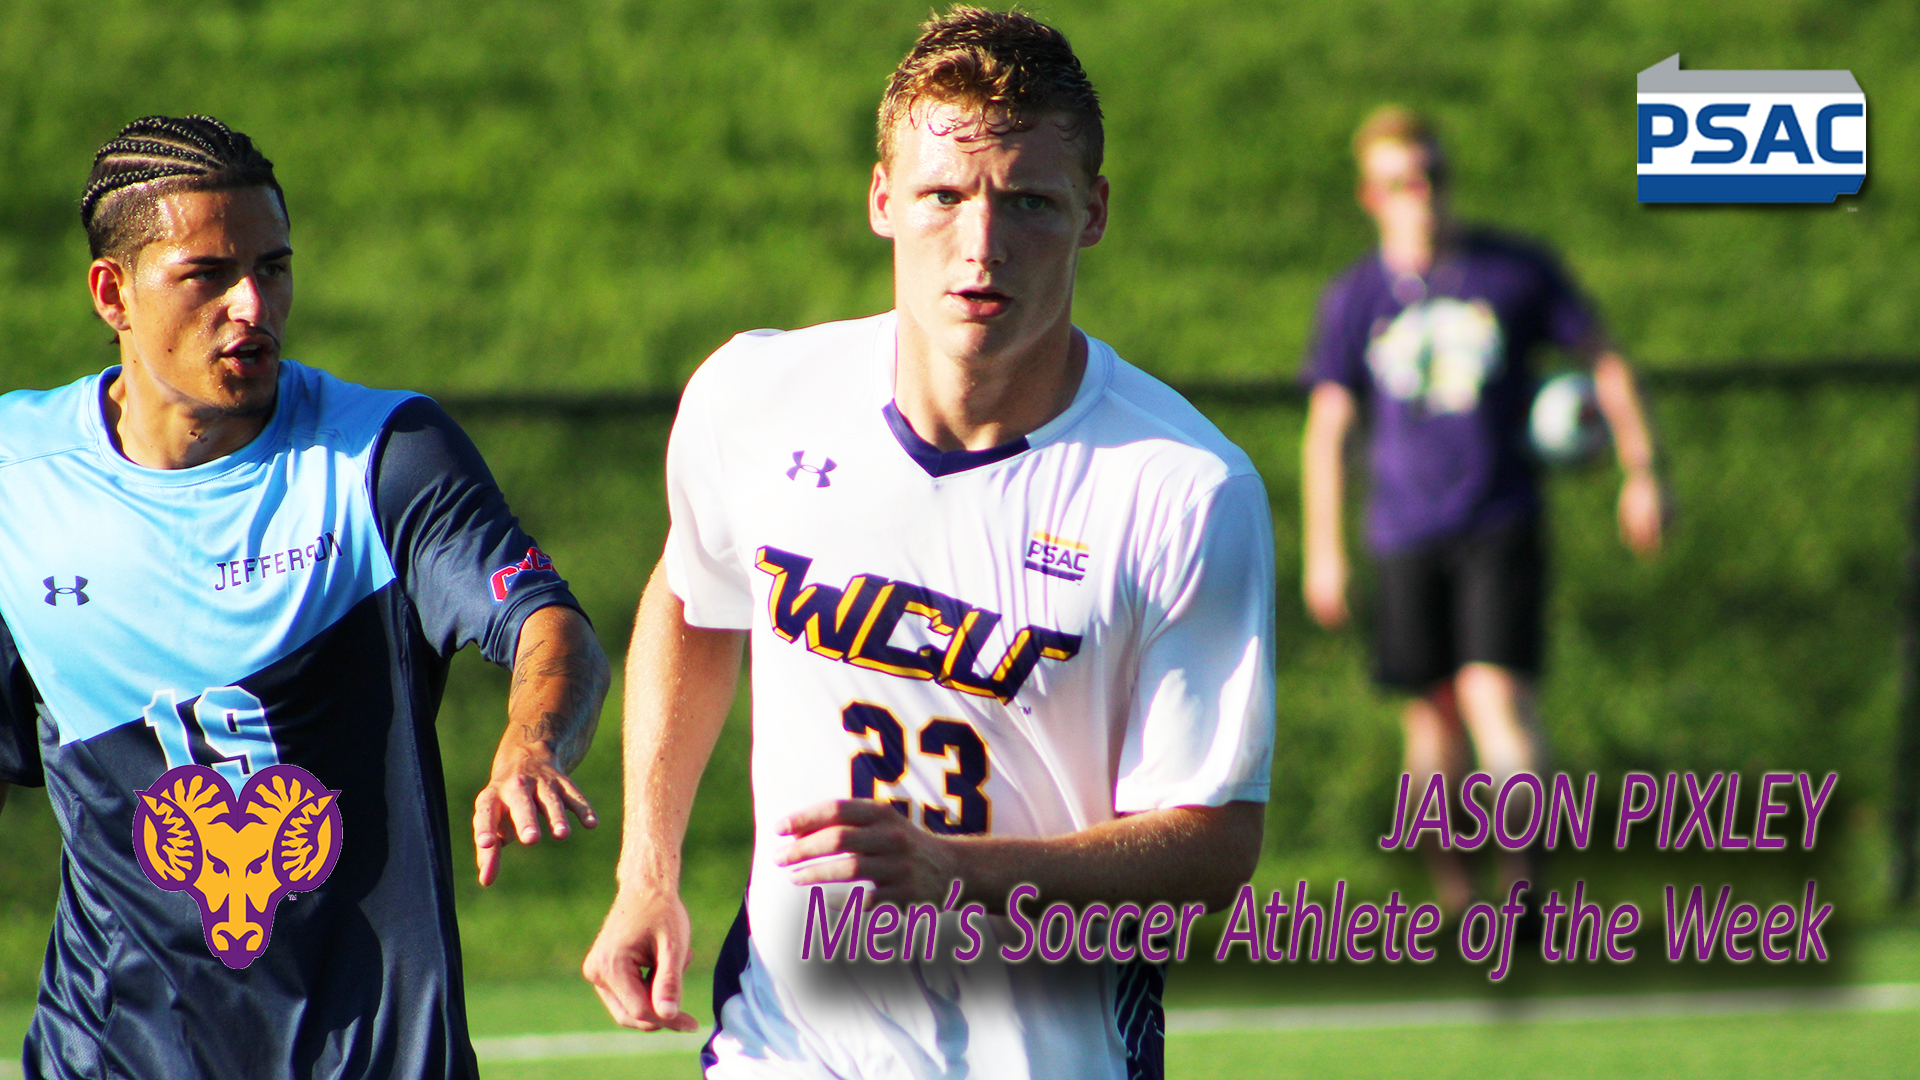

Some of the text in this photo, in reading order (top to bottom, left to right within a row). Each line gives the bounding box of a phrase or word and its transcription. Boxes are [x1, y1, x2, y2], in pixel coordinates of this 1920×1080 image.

[214, 530, 343, 591] JEFFERSON
[1026, 539, 1089, 573] PSAC
[755, 545, 1083, 706] WCU
[142, 685, 281, 798] 19
[841, 699, 991, 837] 23
